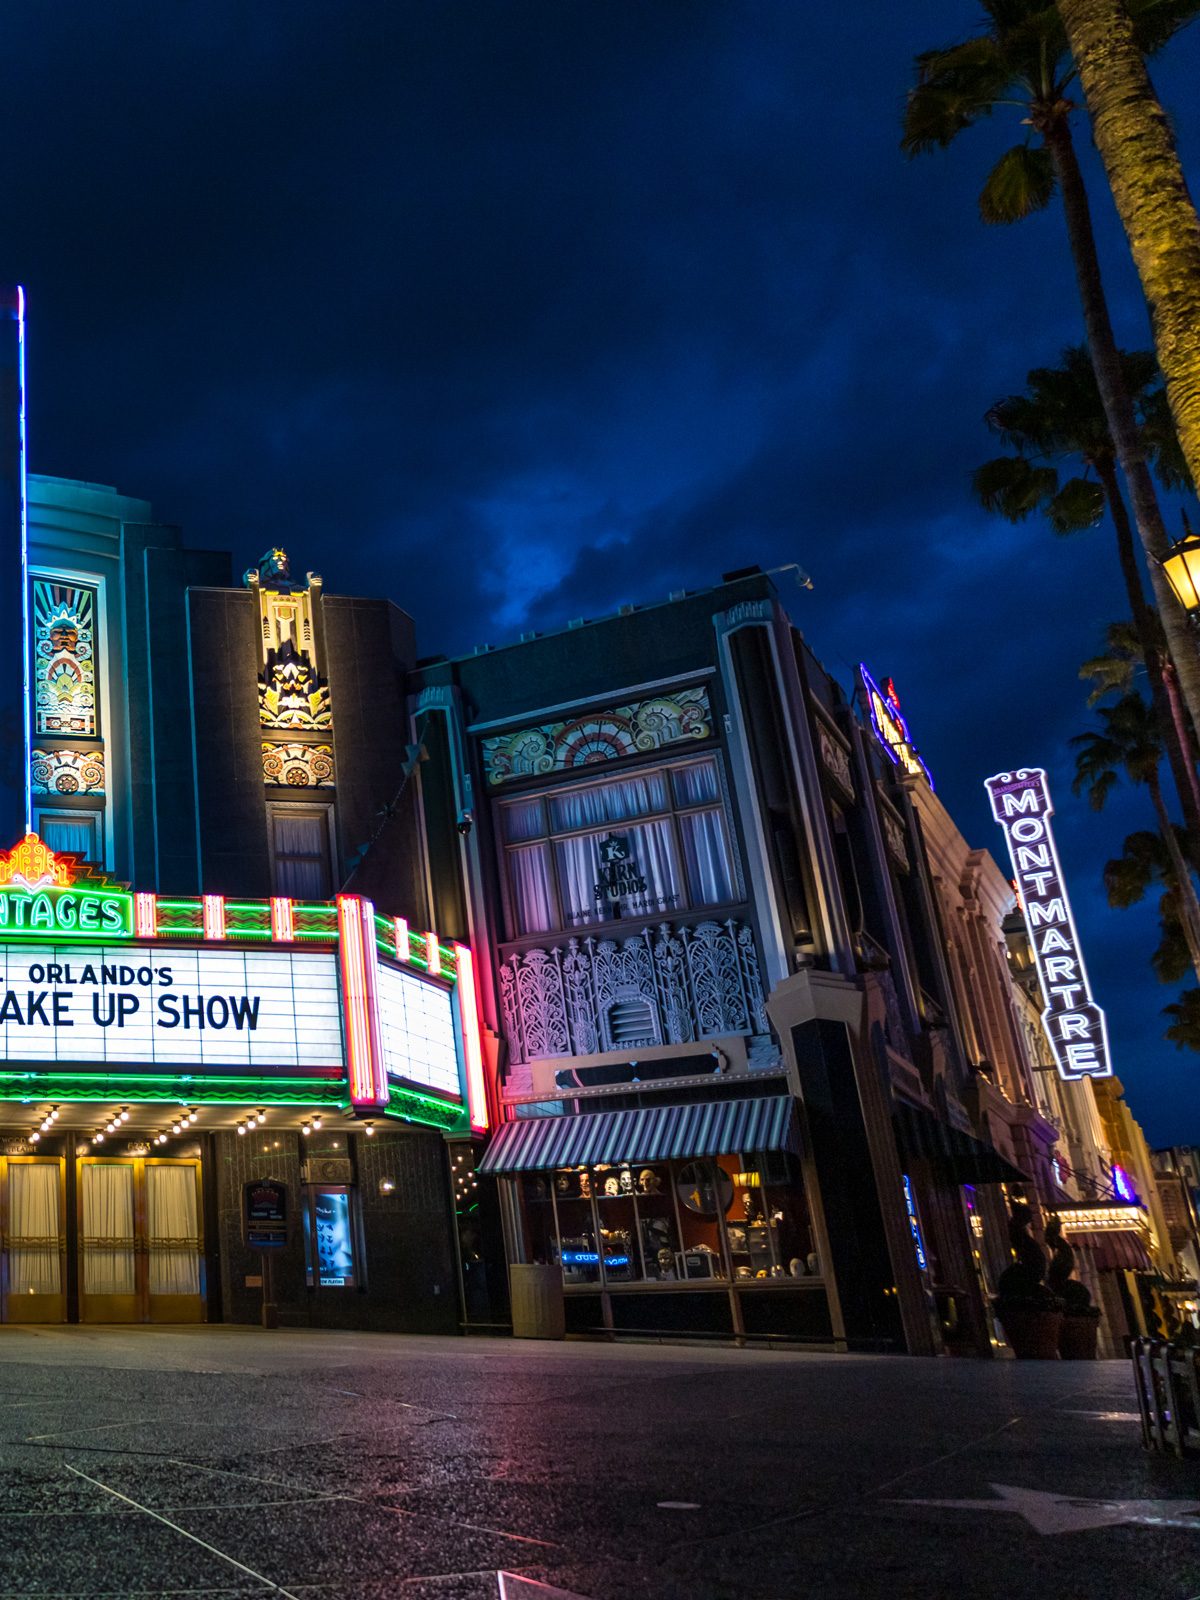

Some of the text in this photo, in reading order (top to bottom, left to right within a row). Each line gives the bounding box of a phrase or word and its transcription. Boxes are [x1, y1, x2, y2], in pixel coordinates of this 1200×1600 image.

[606, 846, 625, 860] K
[593, 877, 648, 901] STUDIOS
[1002, 788, 1100, 1070] MONTMARTRE
[28, 963, 174, 987] ORLANDO'S
[92, 992, 140, 1028] UP
[156, 994, 261, 1031] SHOW
